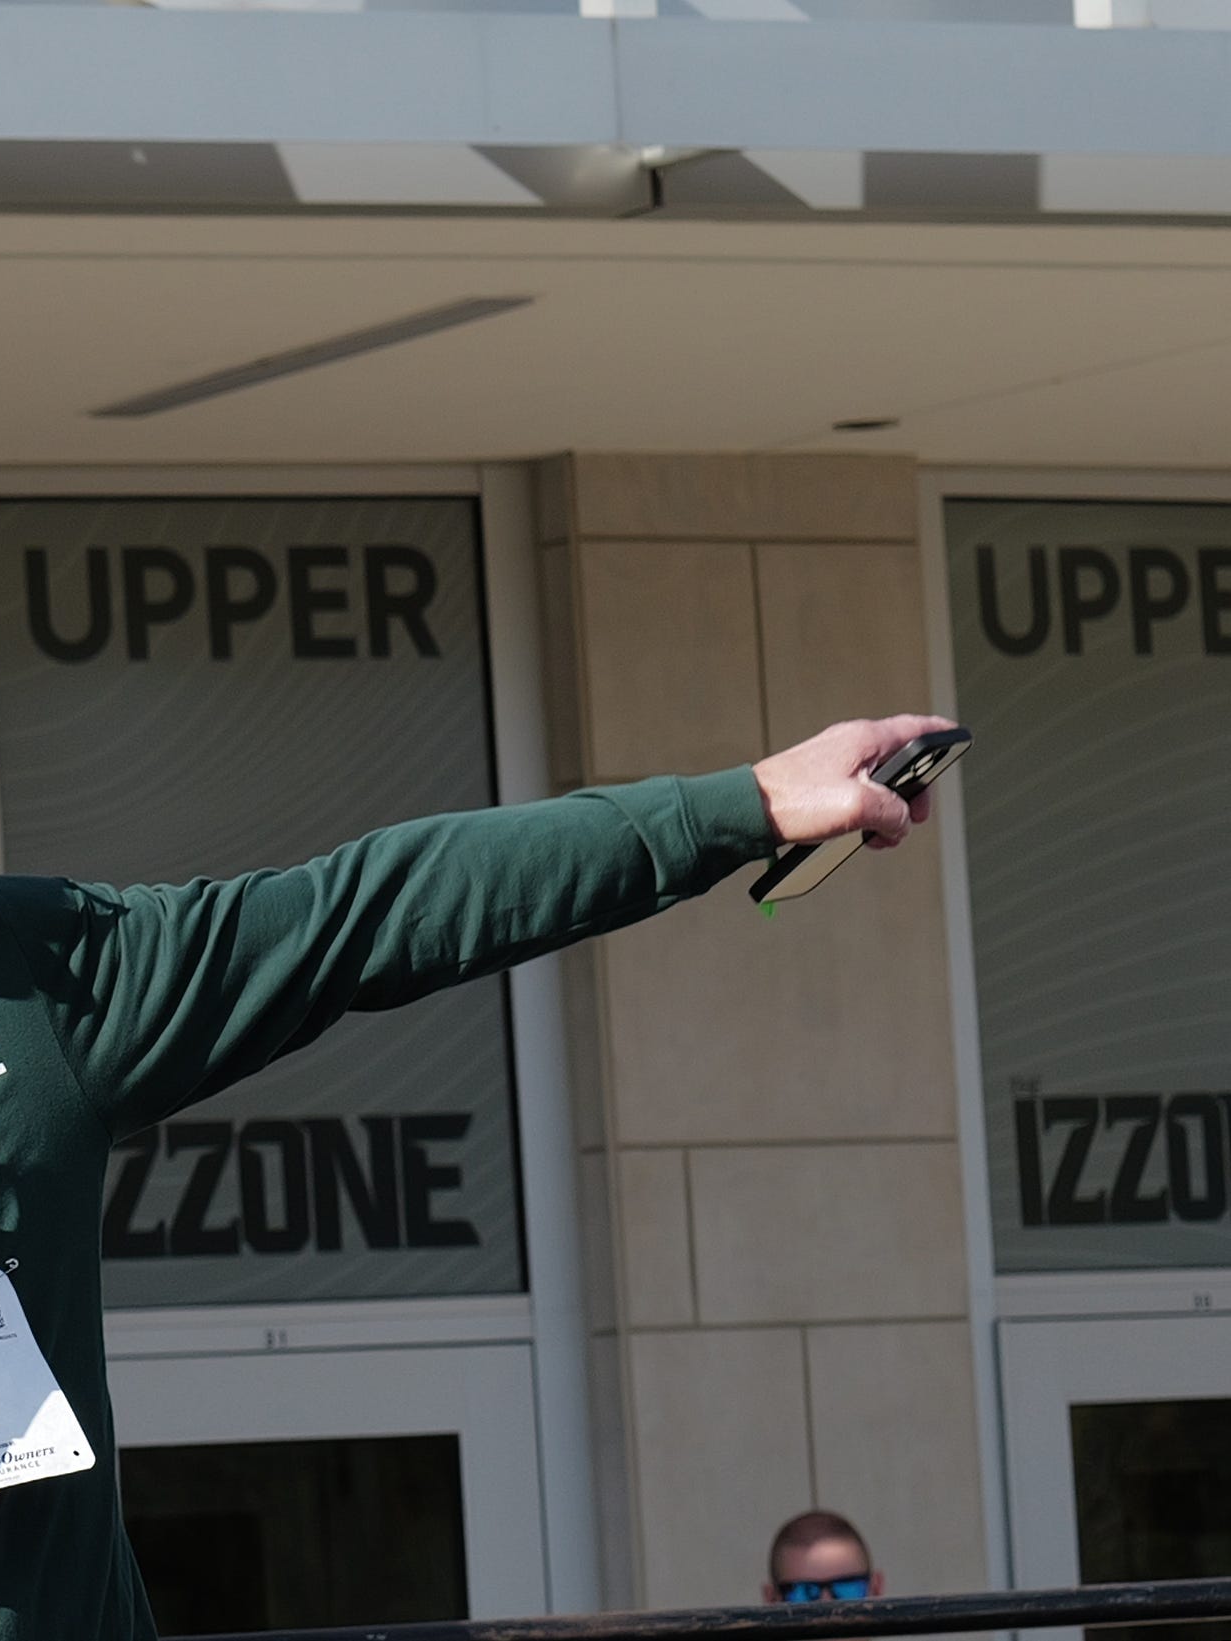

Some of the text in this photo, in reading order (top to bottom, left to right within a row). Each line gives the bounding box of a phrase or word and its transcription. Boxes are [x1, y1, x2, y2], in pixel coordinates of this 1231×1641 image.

[24, 543, 441, 664] UPPER
[975, 544, 1231, 657] UPPE
[102, 1113, 482, 1258] ZZONE
[1014, 1094, 1231, 1227] IZZO
